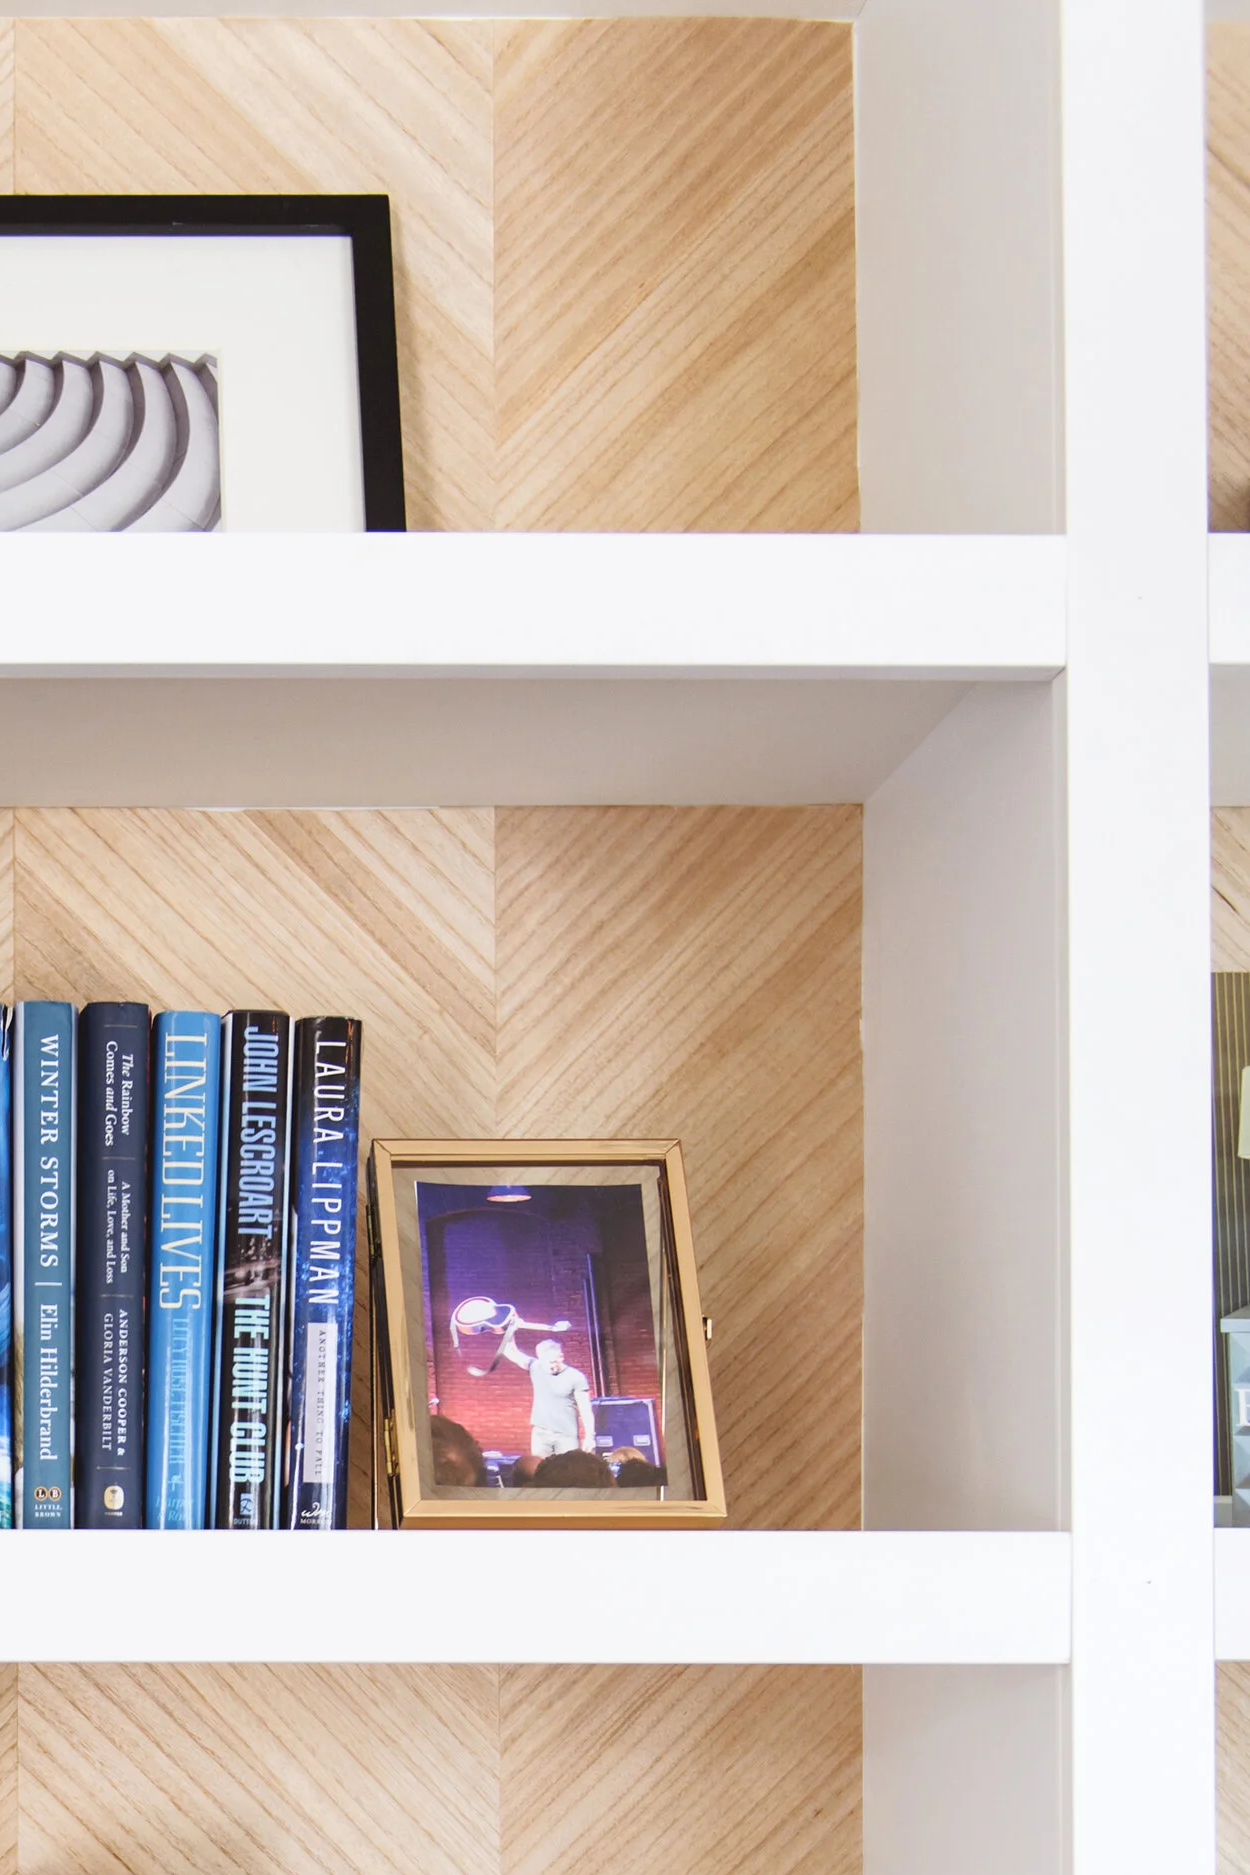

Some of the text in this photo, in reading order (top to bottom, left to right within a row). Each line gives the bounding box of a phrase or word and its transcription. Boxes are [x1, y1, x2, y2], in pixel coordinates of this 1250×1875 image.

[40, 1033, 59, 1268] WINTER STORMS
[104, 1041, 118, 1147] Comes and Goes
[121, 1053, 134, 1136] The Rainbow
[238, 1026, 280, 1240] JOHN LESCROART
[107, 1169, 115, 1184] on
[120, 1181, 131, 1273] A Mother and Son
[159, 1032, 207, 1310] LINKED LIVES
[308, 1041, 347, 1304] LAURA LIPPMAN
[105, 1258, 117, 1284] Loss
[106, 1239, 117, 1256] and
[40, 1303, 59, 1461] Elin Hilderbrand
[102, 1313, 114, 1451] GLORIA VANDERBILT
[118, 1309, 129, 1384] ANDERSON
[229, 1294, 271, 1484] THE HUNT CLUB
[314, 1329, 327, 1476] ANOTHER THING TO FALL
[117, 1388, 128, 1445] COOPER
